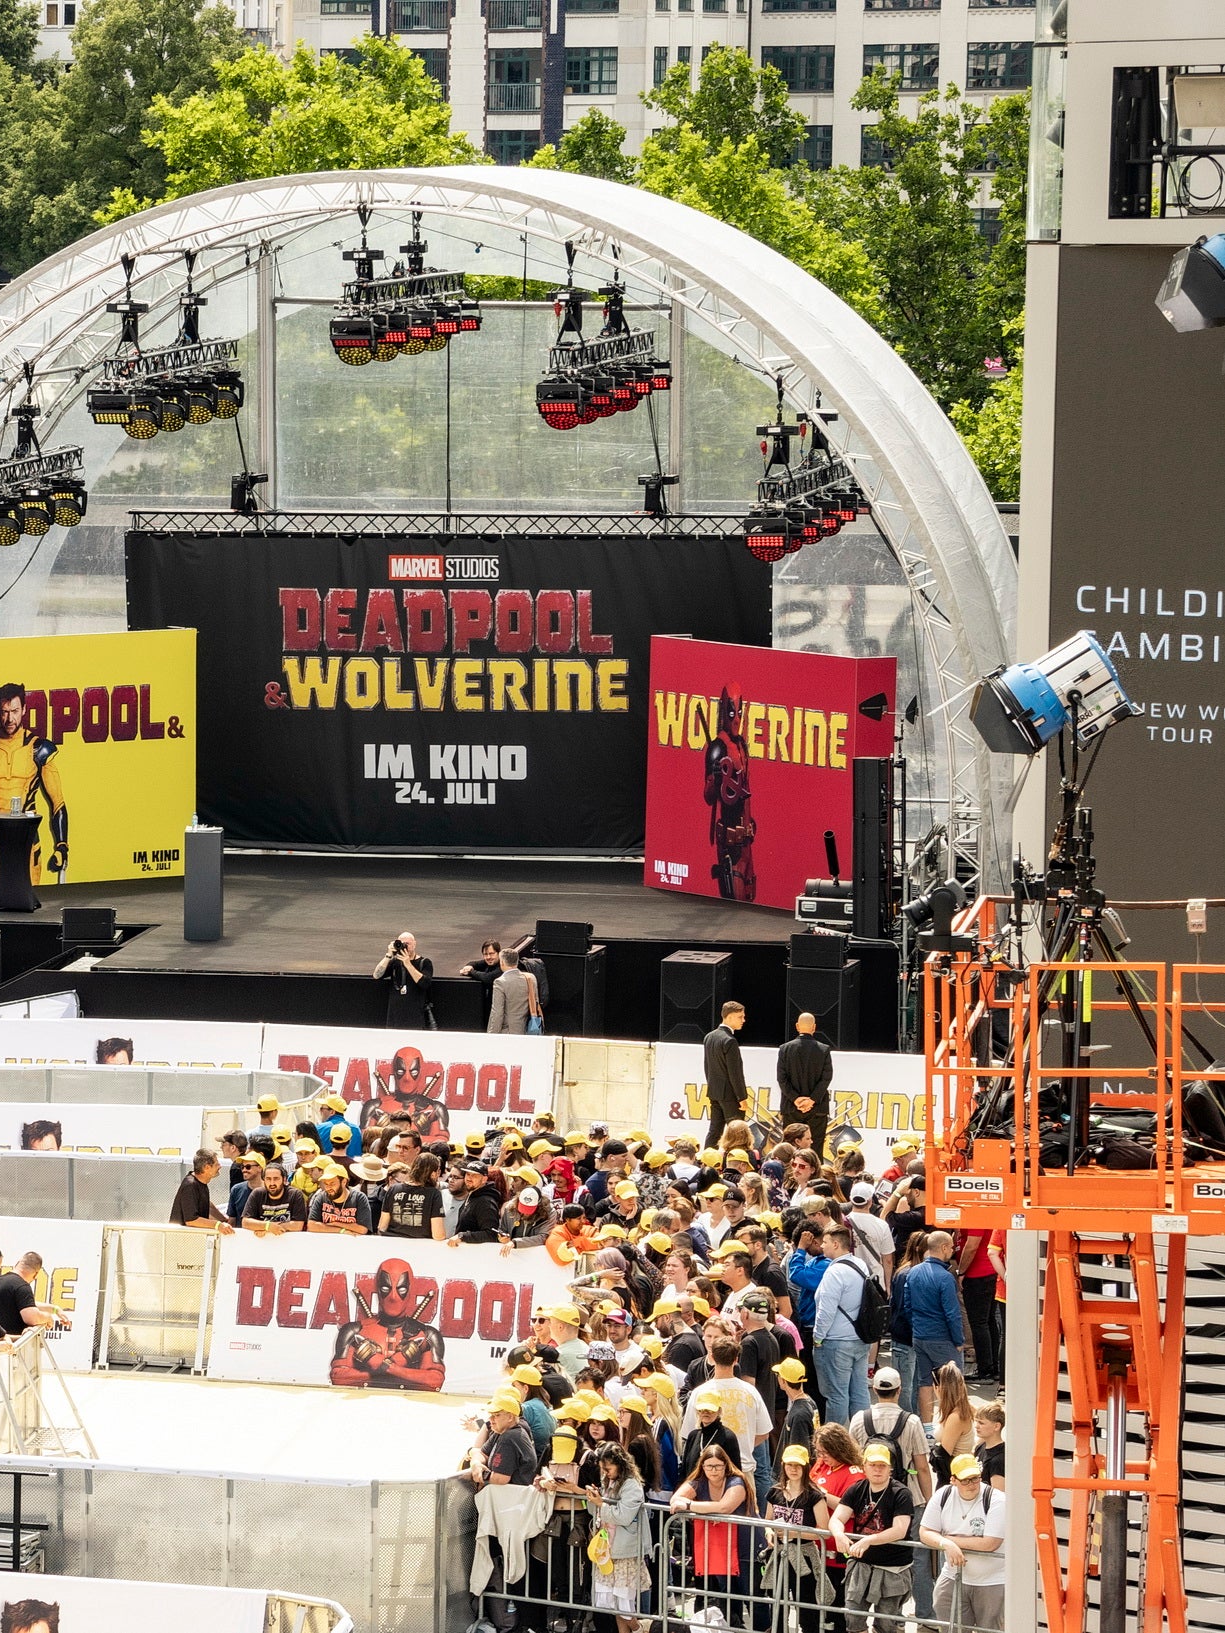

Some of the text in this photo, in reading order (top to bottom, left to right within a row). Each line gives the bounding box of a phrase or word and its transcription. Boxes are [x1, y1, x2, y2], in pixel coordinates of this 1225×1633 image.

[390, 556, 500, 579] MARVEL STUDIOS
[1076, 585, 1224, 618] CHILDI
[278, 587, 614, 654] DEADPOOL
[1078, 630, 1221, 663] AMBI
[281, 656, 630, 713] WOLVERINE
[1146, 725, 1214, 744] TOUR
[363, 743, 528, 780] IM KINO
[394, 781, 497, 805] 24. JULI
[133, 849, 180, 864] IM KINO
[140, 862, 172, 872] 24. JULI
[654, 859, 689, 877] IM KINO
[670, 876, 683, 886] JULI
[948, 1178, 1000, 1191] Boels
[1196, 1185, 1225, 1196] Bo
